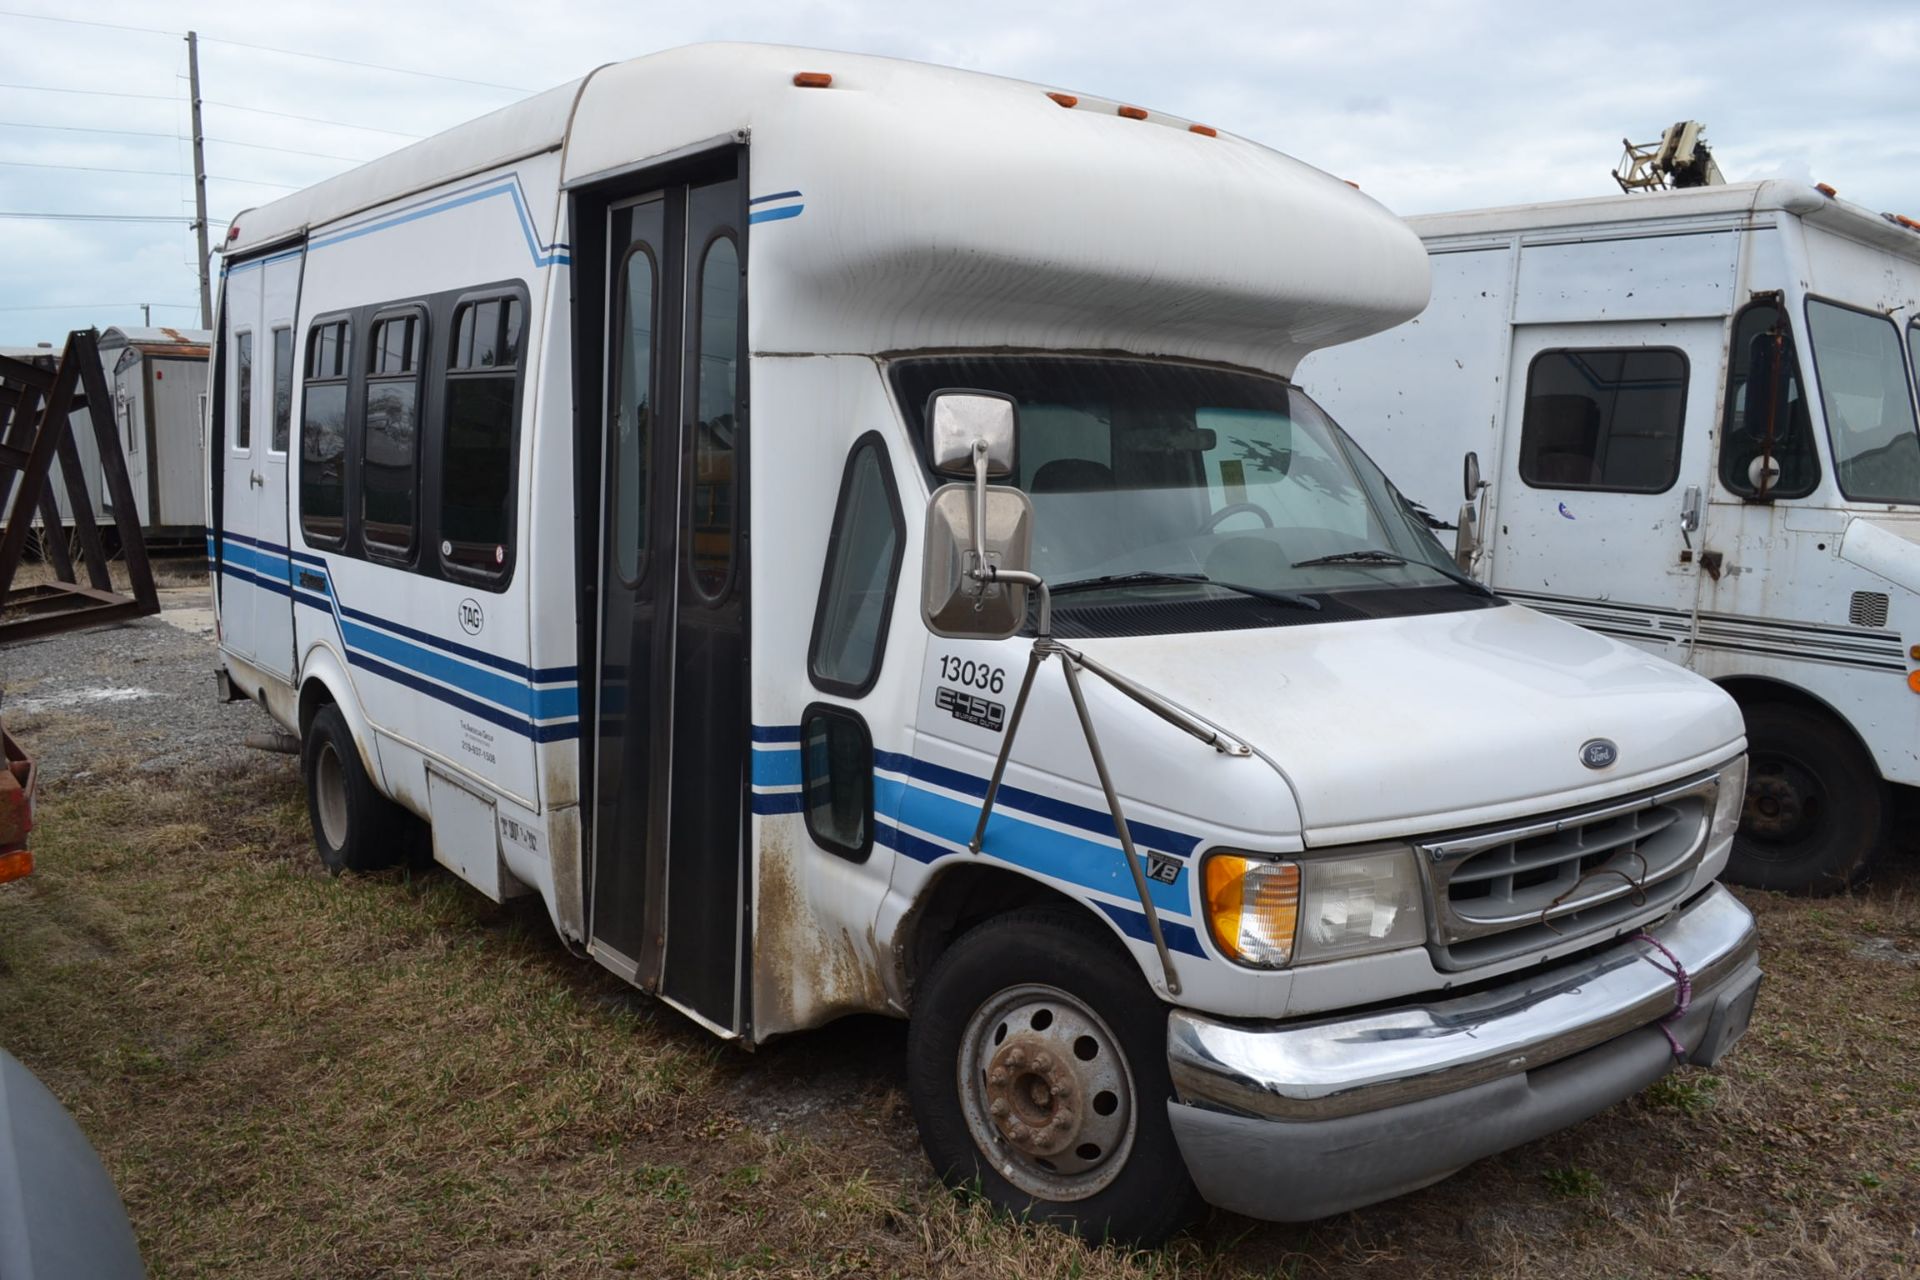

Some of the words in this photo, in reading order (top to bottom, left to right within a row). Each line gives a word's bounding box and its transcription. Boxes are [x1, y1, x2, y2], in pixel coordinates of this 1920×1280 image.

[462, 605, 479, 628] TAG
[940, 654, 1006, 694] 13036
[954, 711, 979, 724] SUPER
[1590, 746, 1611, 762] Ford
[1146, 856, 1179, 881] V8
